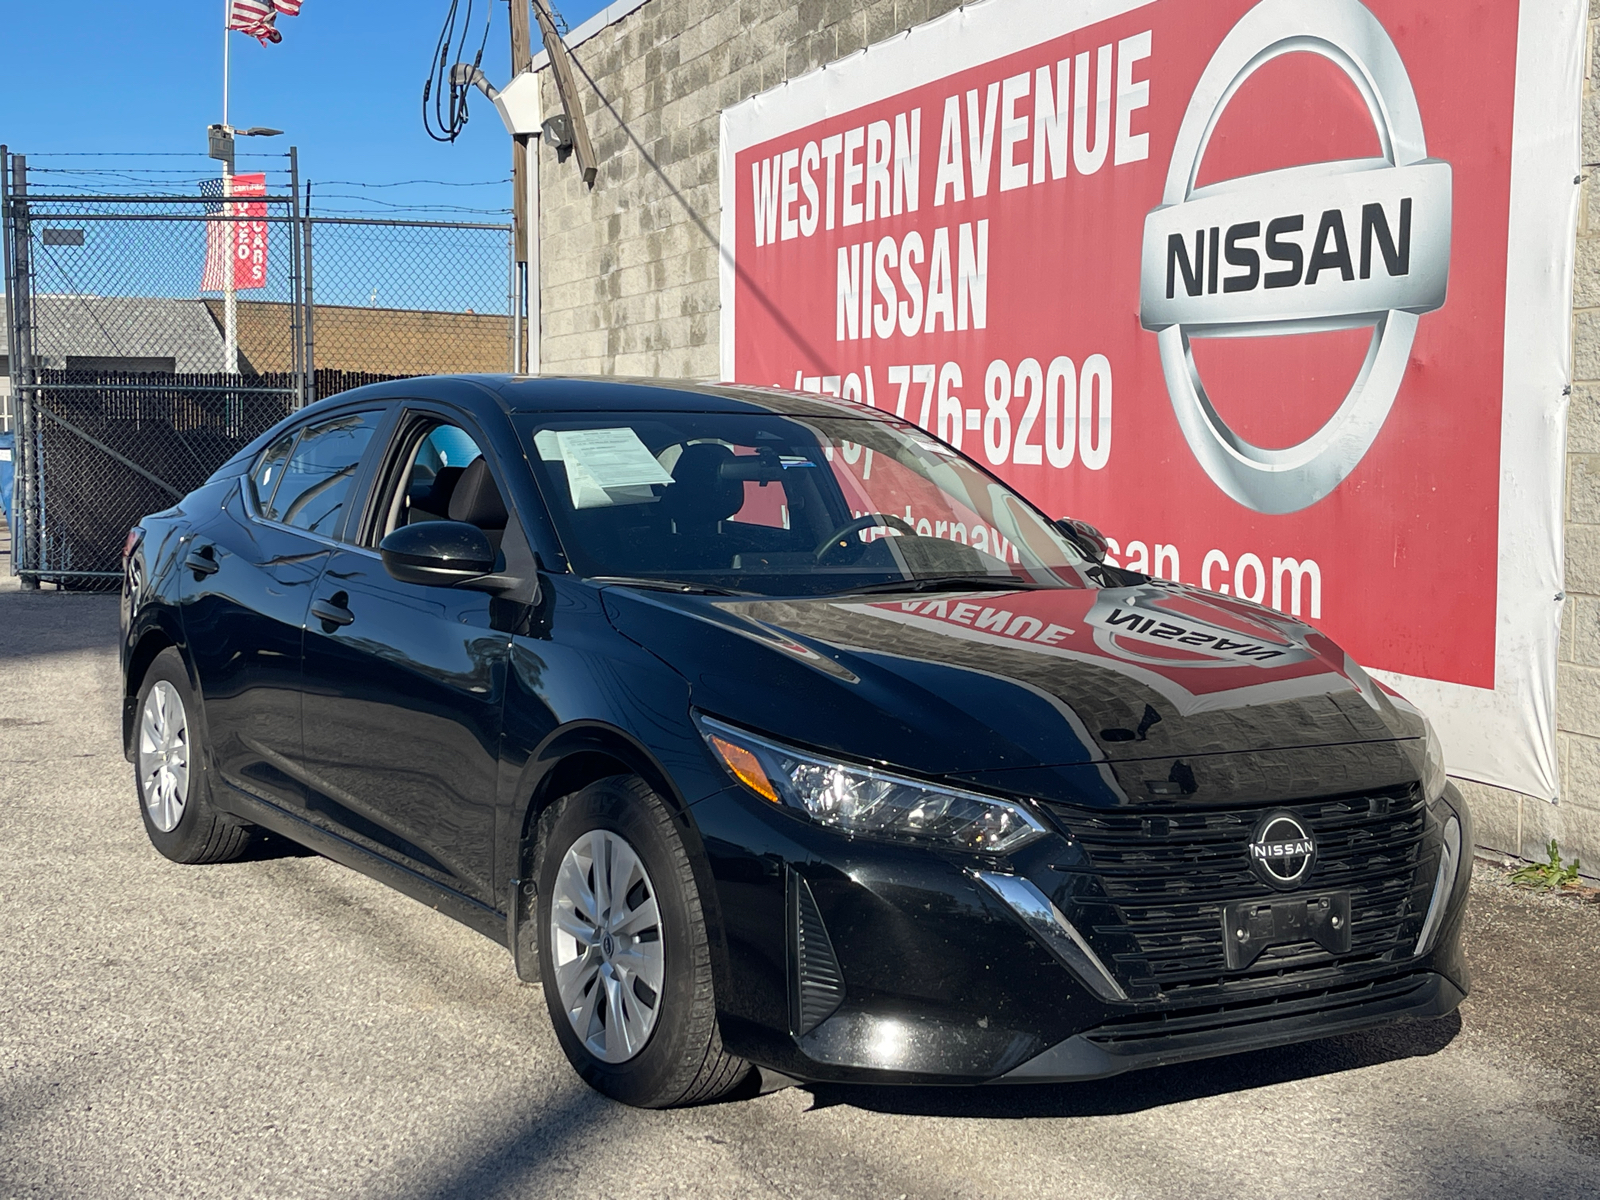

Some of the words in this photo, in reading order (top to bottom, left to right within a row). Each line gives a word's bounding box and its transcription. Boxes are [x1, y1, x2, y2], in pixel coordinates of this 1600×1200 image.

[751, 107, 921, 248] WESTERN
[933, 29, 1153, 208] AVENUE
[251, 217, 264, 280] CARS
[836, 218, 989, 342] NISSAN
[1165, 196, 1413, 299] NISSAN
[888, 353, 1113, 471] 776-8200
[1254, 840, 1314, 857] NISSAN
